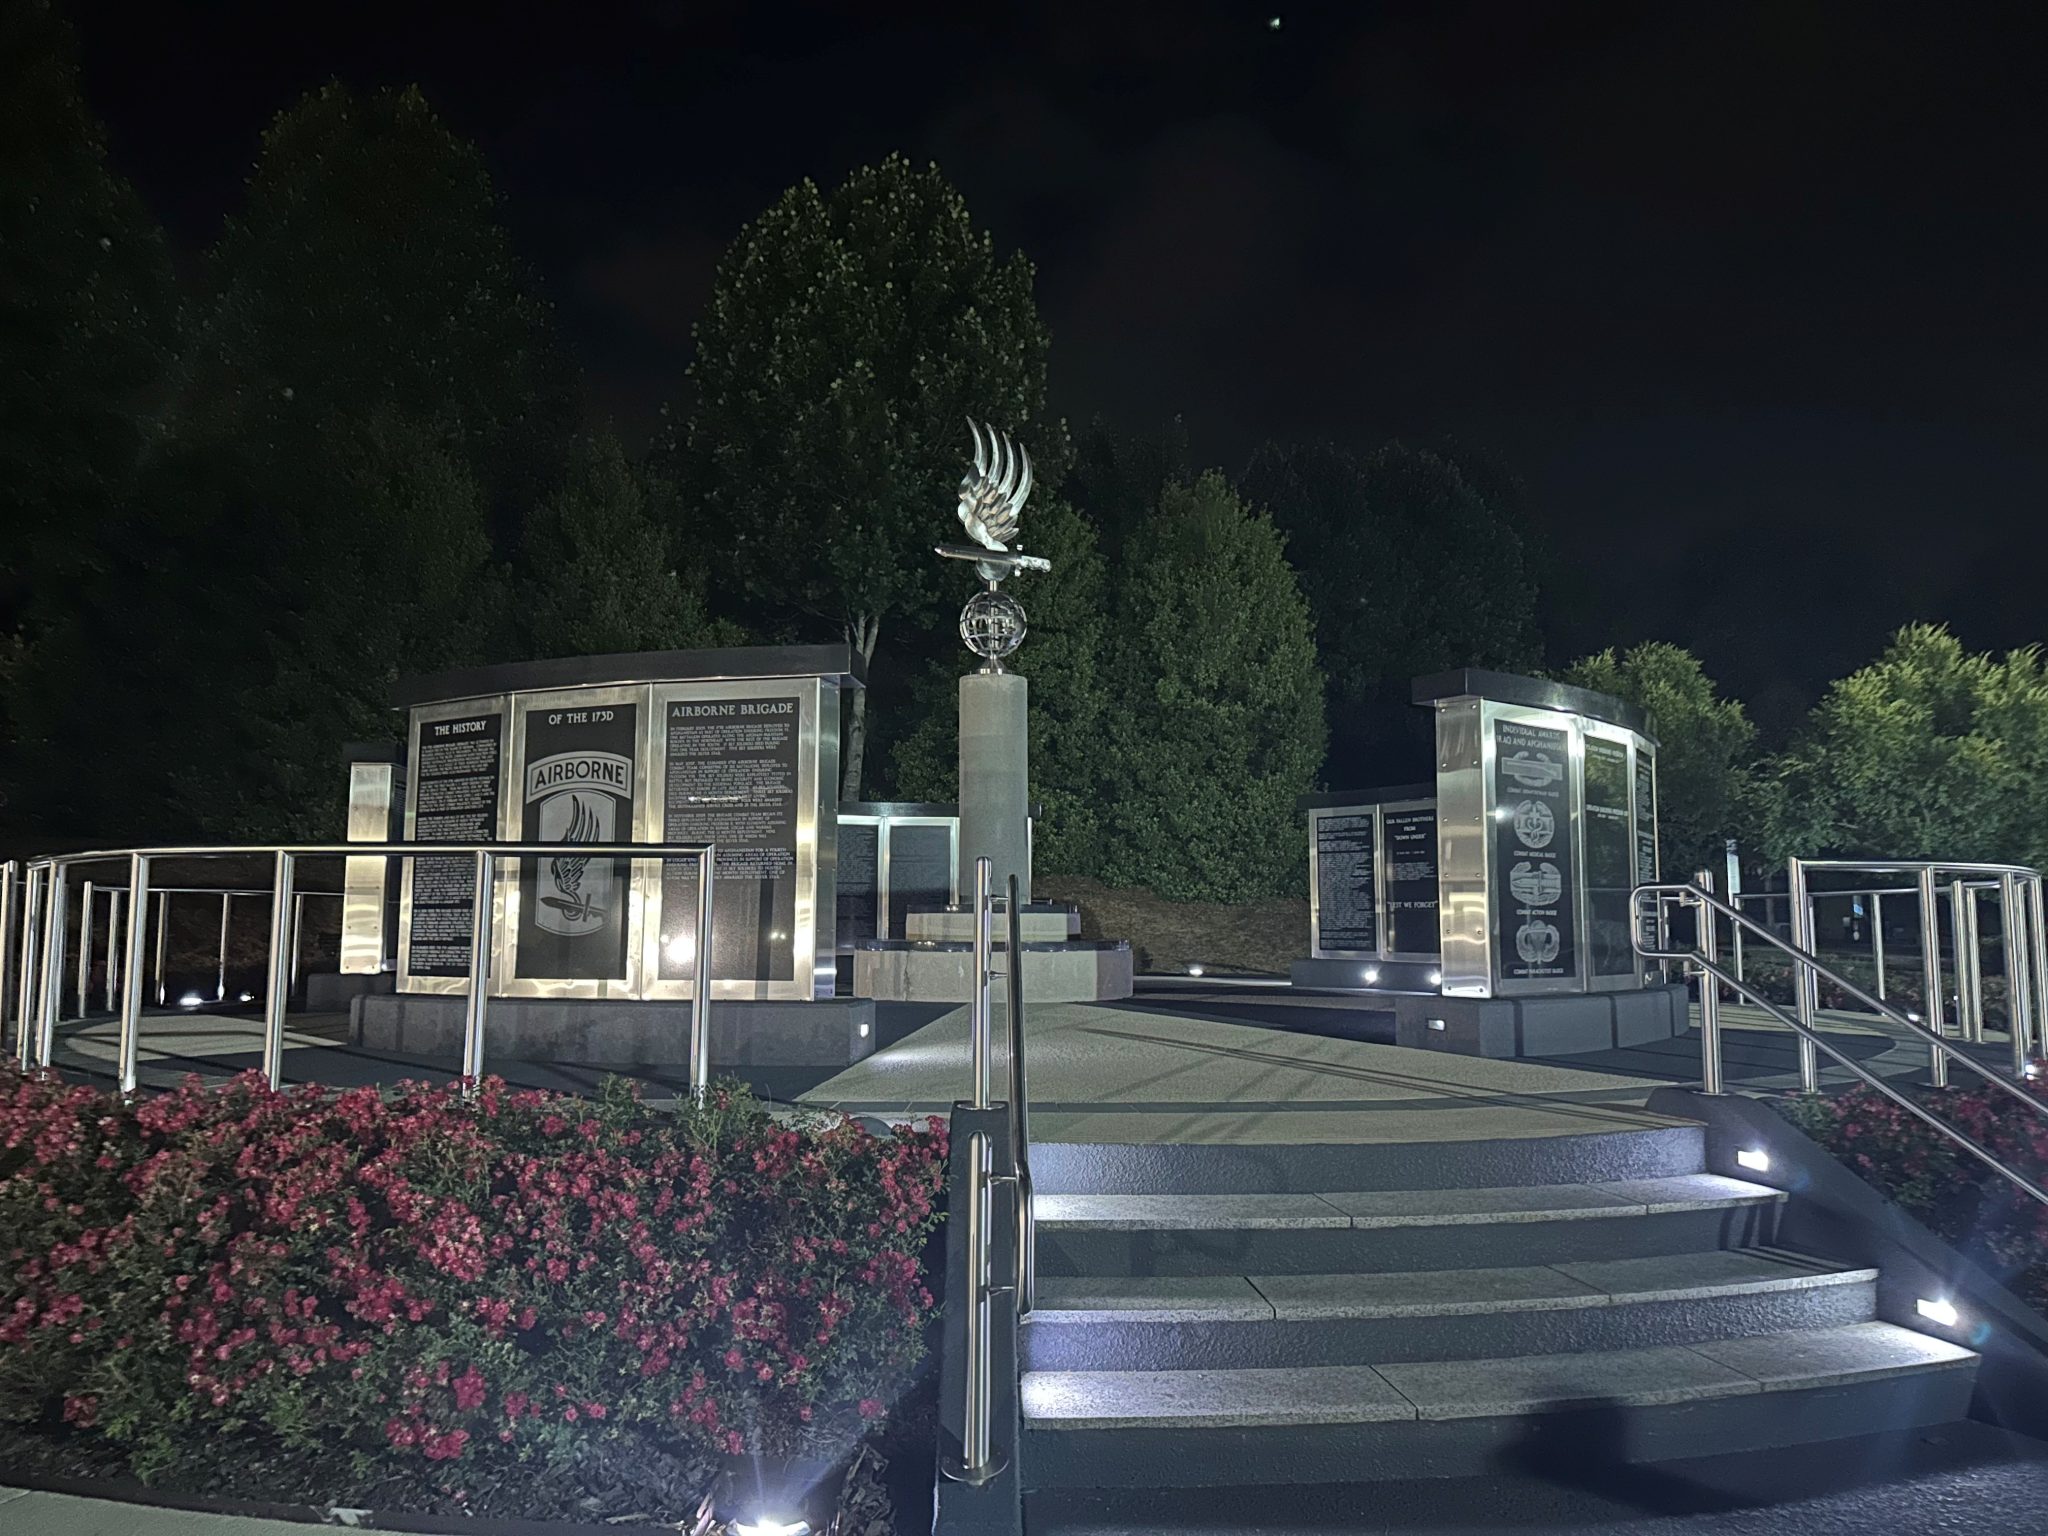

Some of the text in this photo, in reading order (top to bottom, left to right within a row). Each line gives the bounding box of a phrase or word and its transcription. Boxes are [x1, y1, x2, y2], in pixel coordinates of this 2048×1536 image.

[672, 703, 794, 717] AIRBORNE BRIGADE
[548, 711, 614, 724] OF THE 173D
[434, 720, 486, 736] THE HISTORY
[1512, 737, 1526, 746] AND
[535, 760, 624, 790] AIRBORNE
